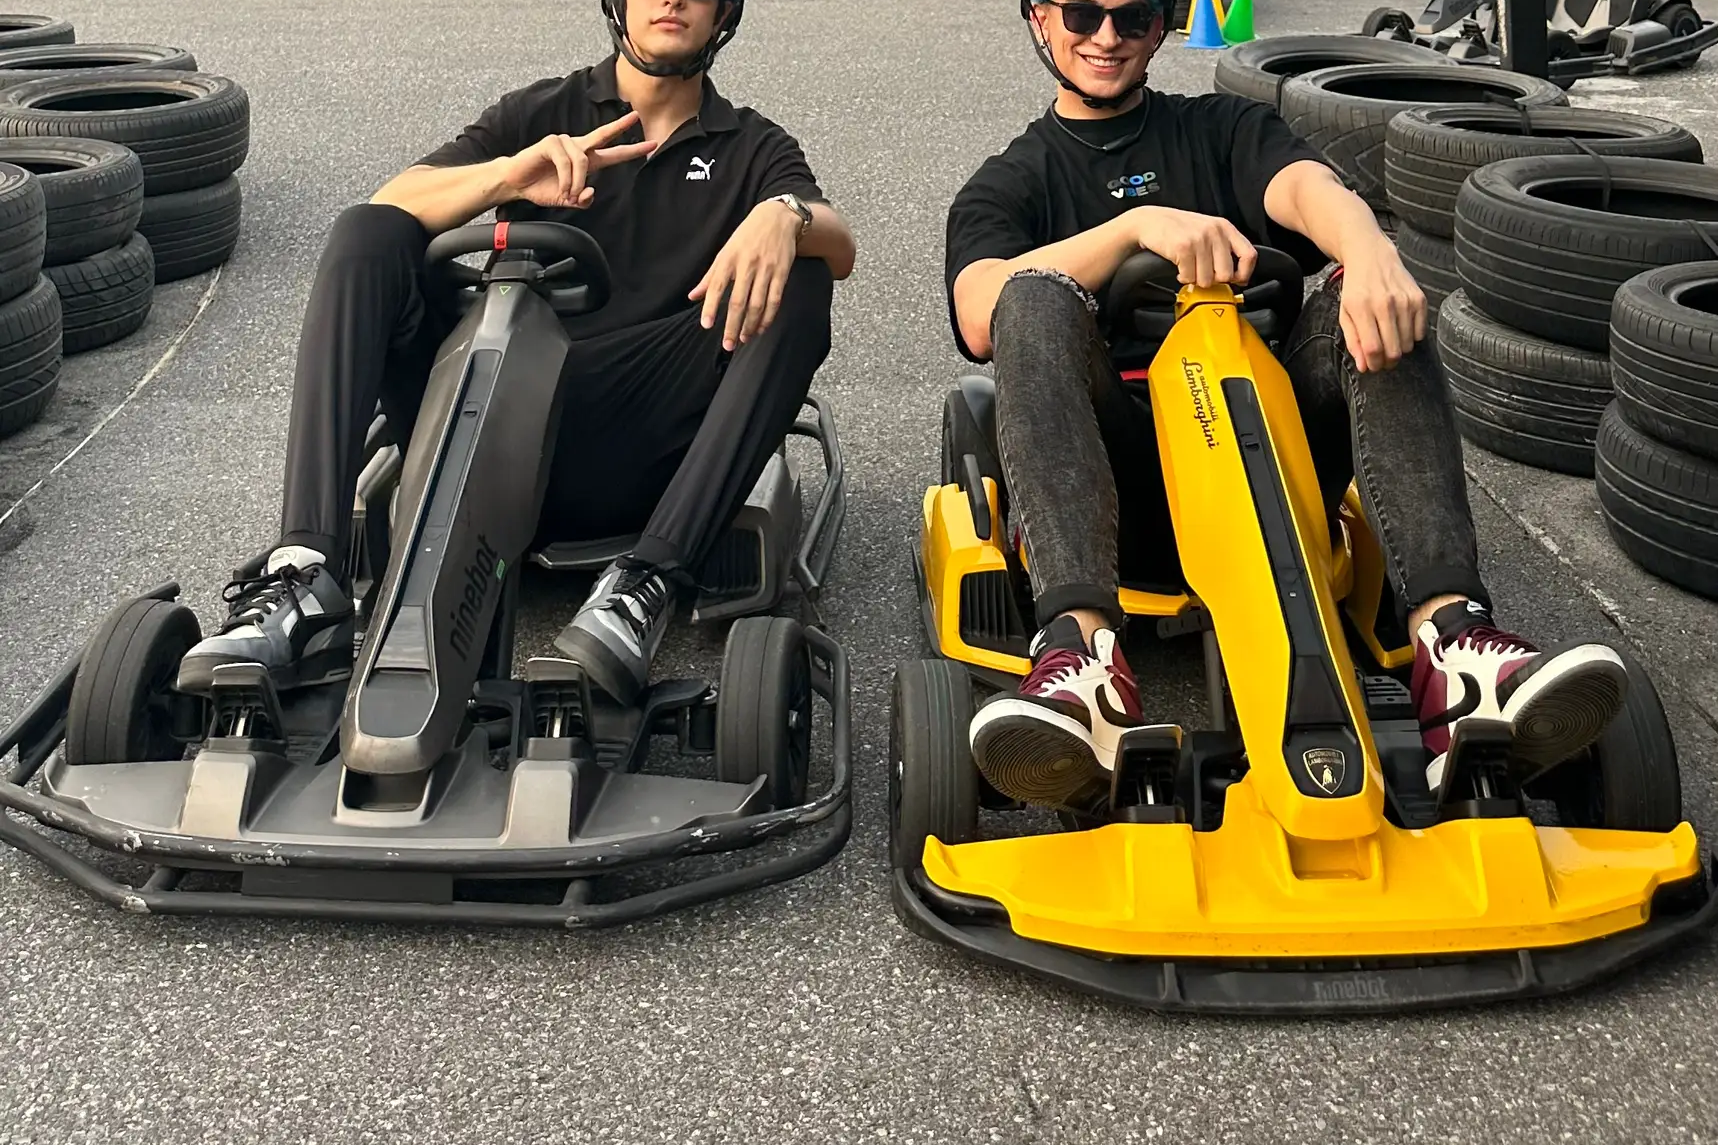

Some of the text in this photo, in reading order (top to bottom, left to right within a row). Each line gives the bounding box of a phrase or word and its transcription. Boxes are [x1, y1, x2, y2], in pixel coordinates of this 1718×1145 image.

[685, 170, 706, 181] PUMA
[1106, 171, 1157, 190] GOOD
[1181, 356, 1220, 450] Lamborghini
[1199, 375, 1219, 423] automobili
[450, 533, 498, 662] ninebot
